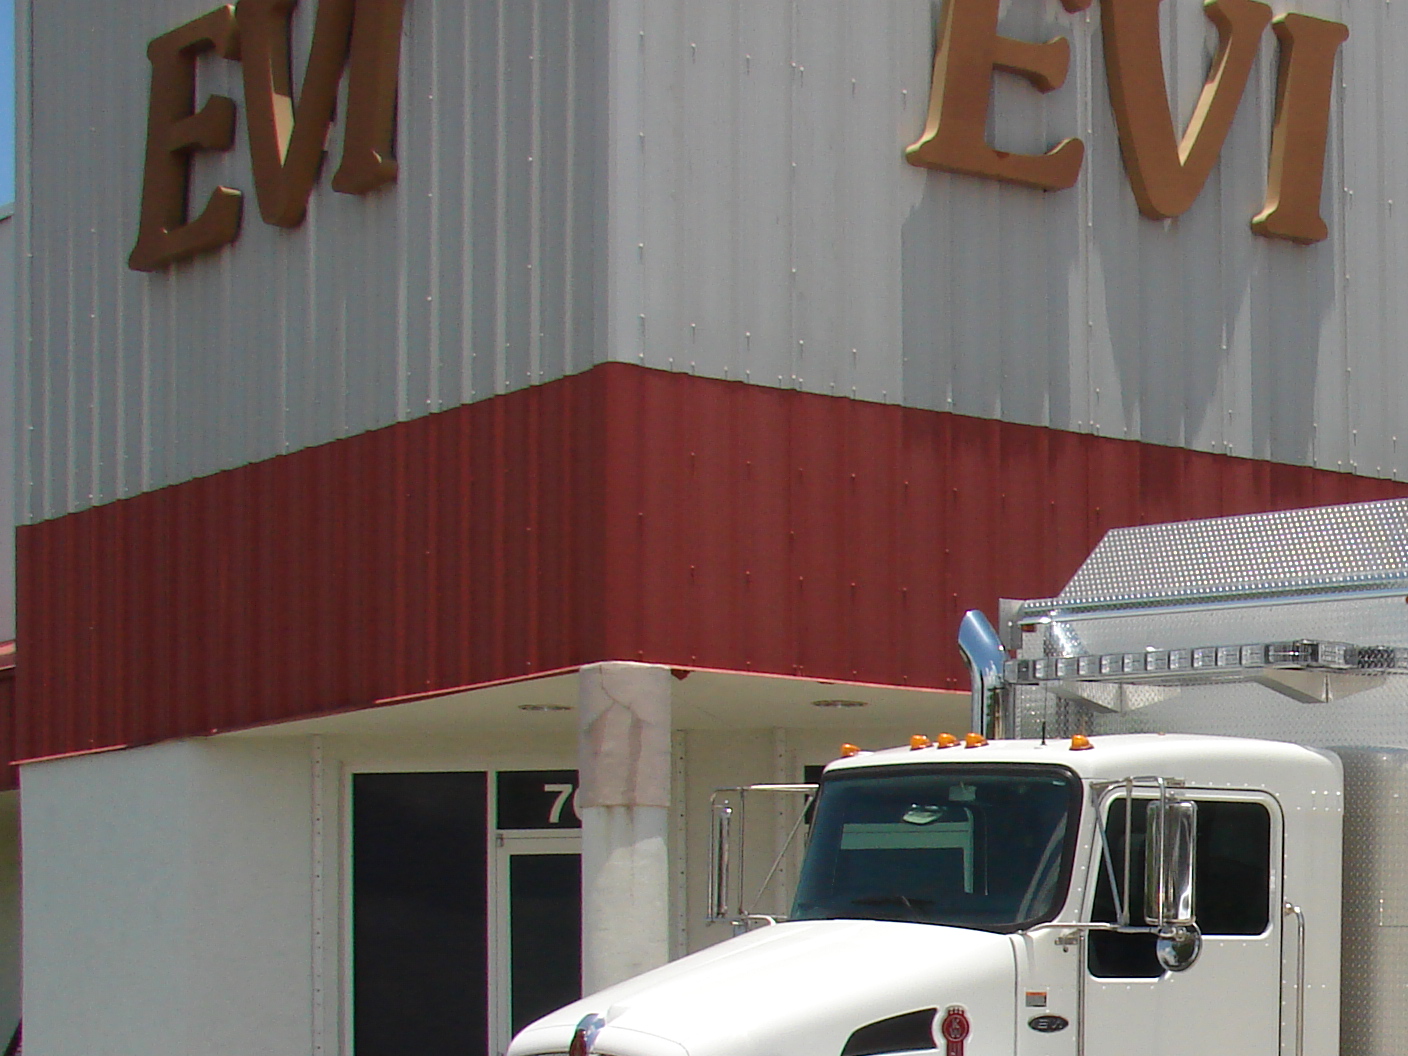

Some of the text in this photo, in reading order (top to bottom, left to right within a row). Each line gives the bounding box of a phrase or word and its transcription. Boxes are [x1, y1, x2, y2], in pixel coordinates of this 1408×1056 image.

[128, 0, 404, 273] EVI
[905, 0, 1349, 245] EVI
[543, 783, 582, 824] 7
